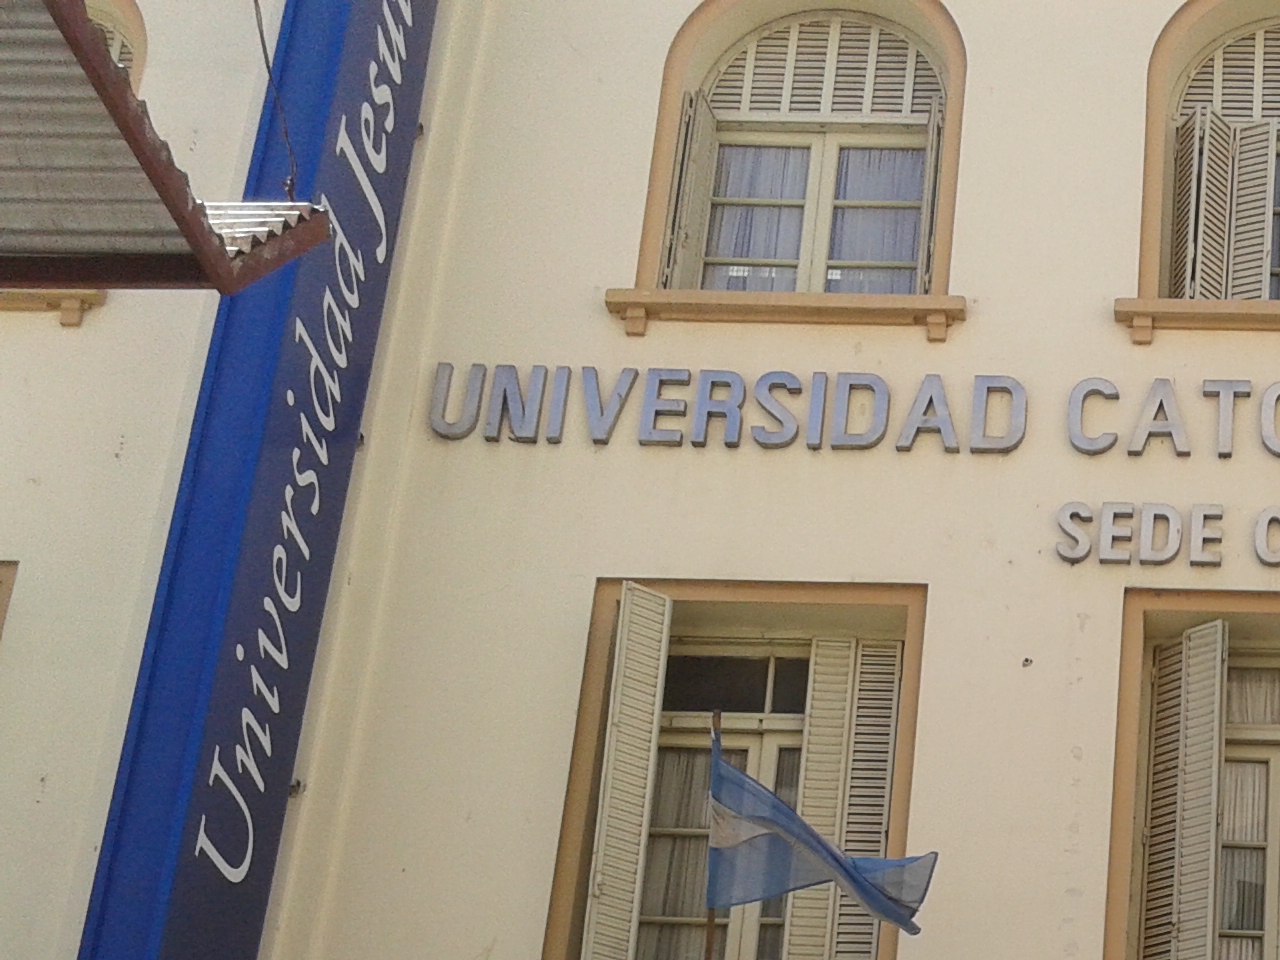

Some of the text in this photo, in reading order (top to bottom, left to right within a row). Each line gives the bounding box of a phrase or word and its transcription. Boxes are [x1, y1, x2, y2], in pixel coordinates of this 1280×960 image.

[428, 362, 1027, 455] UNIVERSIDAD
[195, 195, 366, 882] Universidad
[1055, 502, 1224, 567] SEDE
